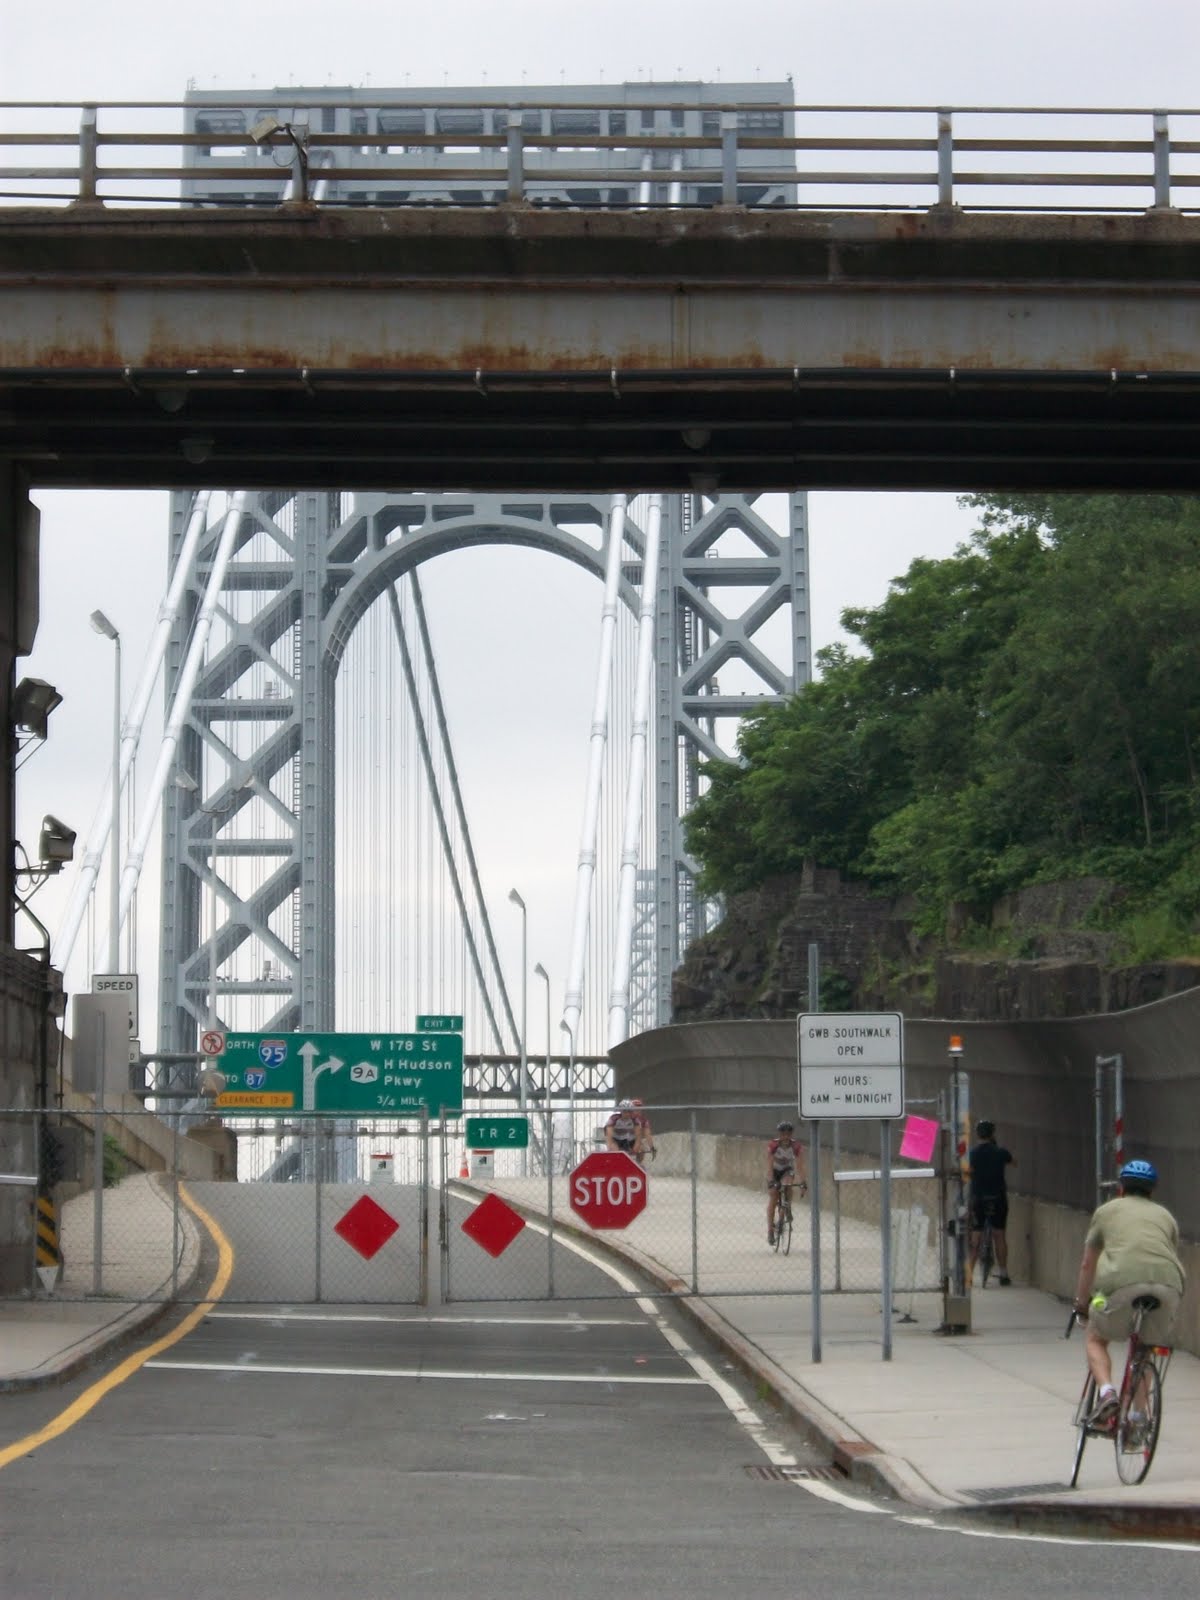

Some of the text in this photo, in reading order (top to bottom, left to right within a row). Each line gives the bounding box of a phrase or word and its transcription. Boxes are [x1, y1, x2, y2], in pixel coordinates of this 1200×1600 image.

[97, 981, 133, 991] SPEED
[424, 1020, 444, 1028] EXIT
[808, 1027, 892, 1039] GWB SOUTHWALK
[226, 1040, 255, 1050] ORTH
[370, 1040, 438, 1051] W 178 St
[837, 1045, 864, 1056] OPEN
[261, 1047, 285, 1062] 95
[384, 1059, 453, 1070] H Hudson
[225, 1074, 238, 1083] TO
[352, 1067, 375, 1079] 9A
[246, 1073, 263, 1086] 87
[384, 1075, 422, 1089] Pkwy
[219, 1095, 265, 1104] CLEARANCE
[377, 1095, 425, 1107] 3/4 MILE
[810, 1093, 830, 1104] 6AM
[844, 1093, 892, 1104] MIDNIGHT
[508, 1128, 516, 1139] 2
[574, 1176, 643, 1207] STOP
